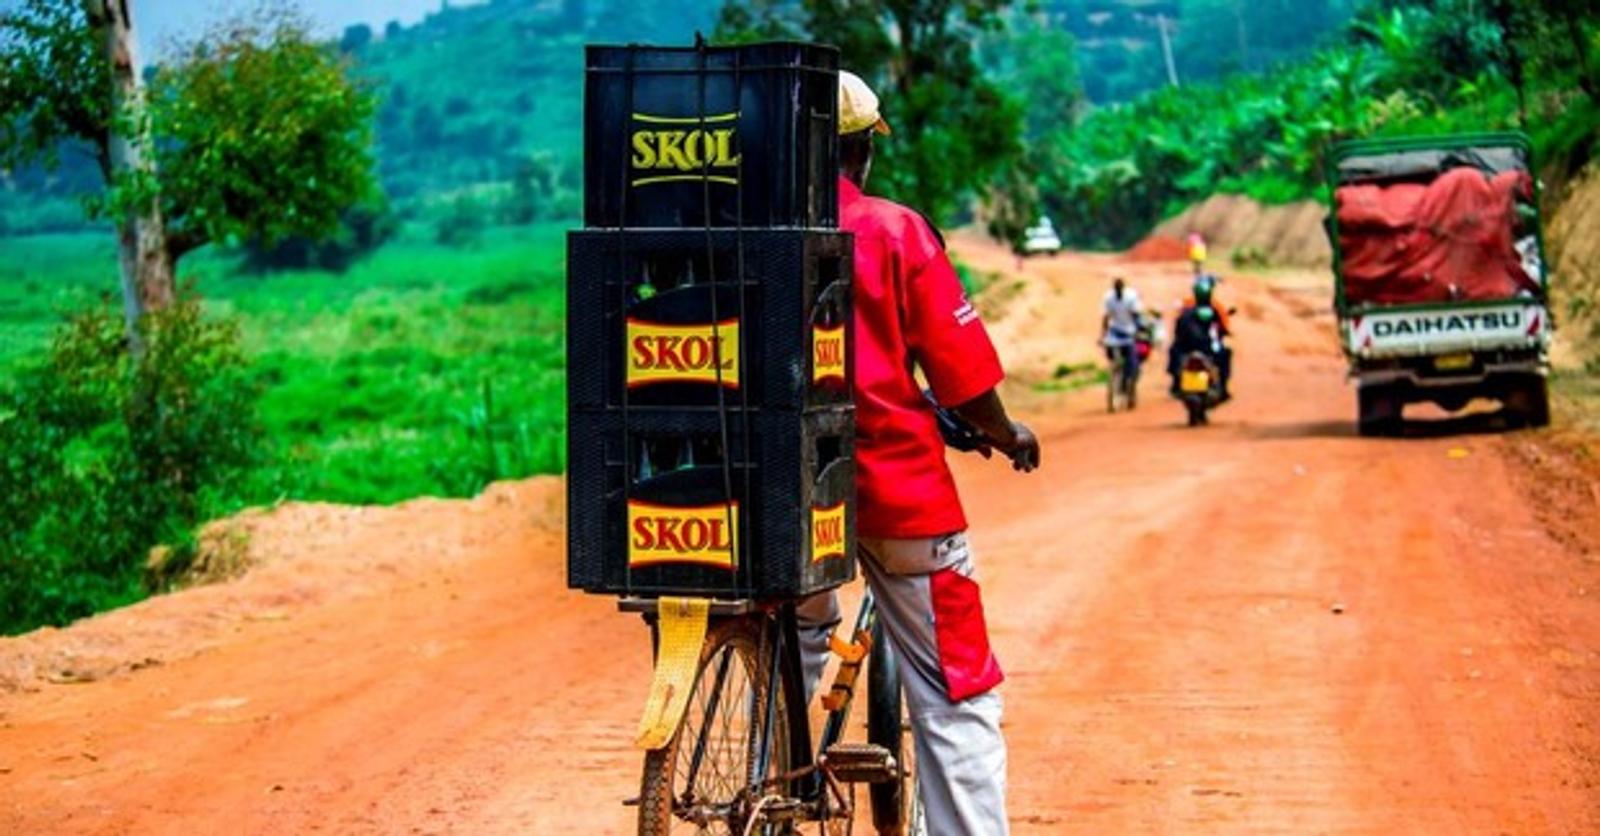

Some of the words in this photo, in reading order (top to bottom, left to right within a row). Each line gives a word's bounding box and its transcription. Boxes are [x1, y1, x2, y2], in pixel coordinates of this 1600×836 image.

[632, 129, 741, 171] SKOL
[1372, 311, 1521, 337] DAIHATSU
[633, 335, 733, 372] SKOL
[815, 338, 842, 369] SKOL
[633, 516, 733, 553] SKOL
